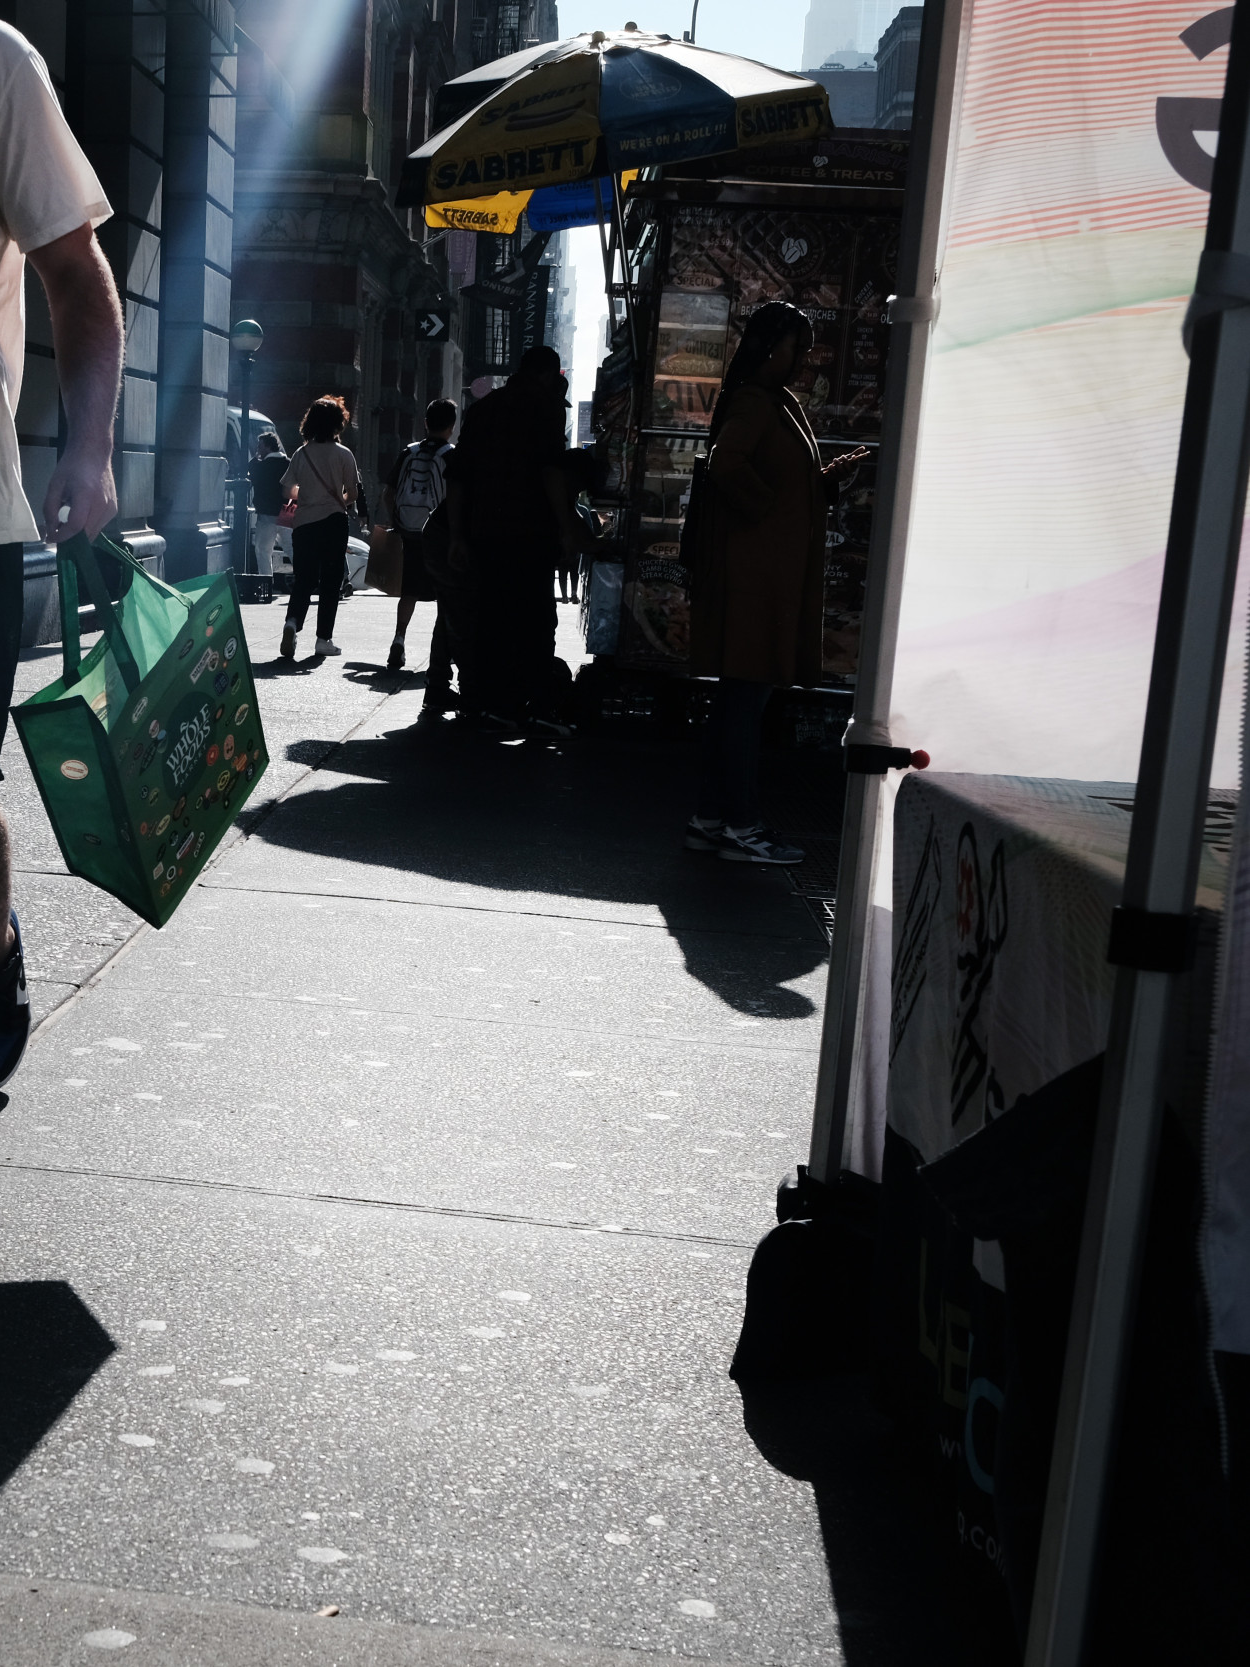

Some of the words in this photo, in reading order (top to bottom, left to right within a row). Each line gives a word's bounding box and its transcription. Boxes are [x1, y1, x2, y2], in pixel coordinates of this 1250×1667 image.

[479, 82, 590, 126] SABRETT
[741, 98, 824, 138] SABRETT
[656, 134, 670, 146] ON
[673, 132, 681, 143] A
[684, 127, 712, 142] ROLL
[434, 139, 590, 190] SABRETT
[745, 164, 811, 178] COFFEE
[815, 167, 828, 179] &
[831, 168, 895, 182] TREATS
[677, 276, 716, 287] SPECIAL
[652, 545, 679, 555] SPECI
[638, 559, 668, 568] CHICKEN
[641, 565, 662, 573] LAMB
[640, 571, 663, 580] STEAK
[664, 573, 683, 585] GYRO
[165, 703, 210, 771] WHOLE
[172, 720, 212, 786] FOODS
